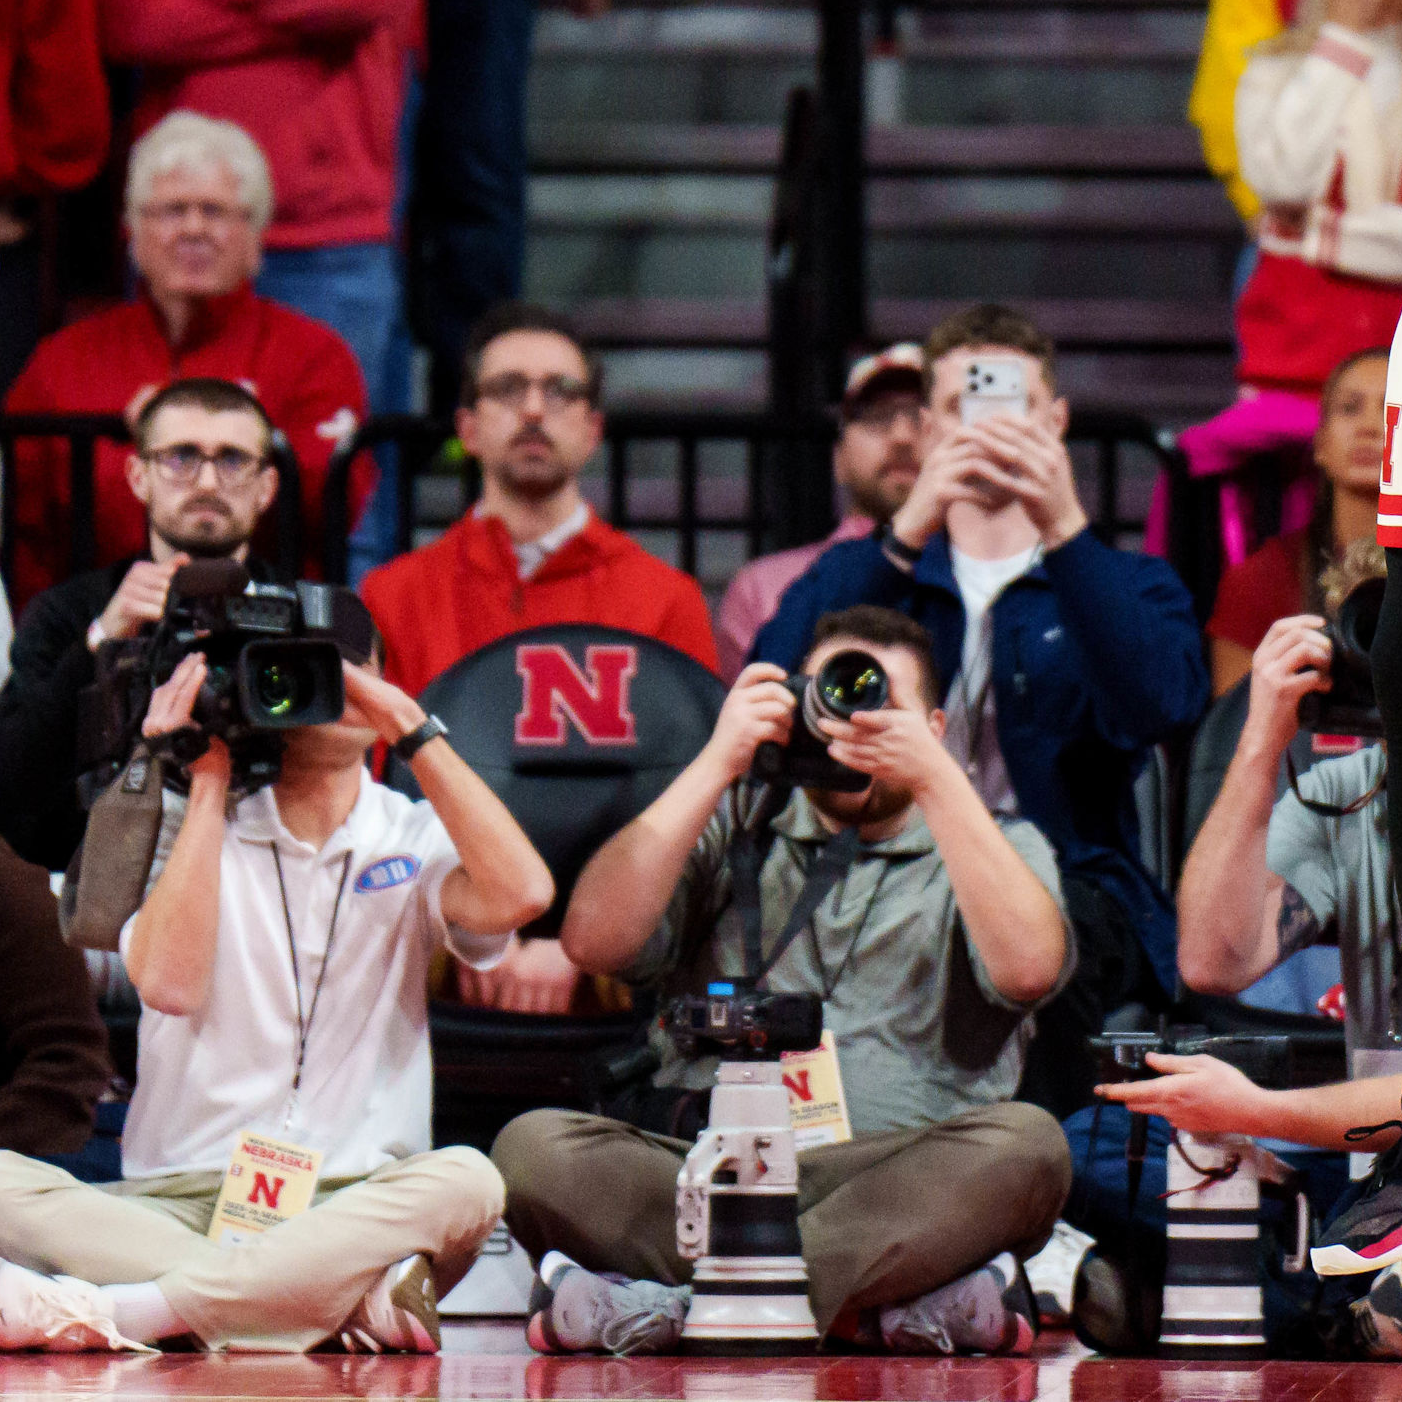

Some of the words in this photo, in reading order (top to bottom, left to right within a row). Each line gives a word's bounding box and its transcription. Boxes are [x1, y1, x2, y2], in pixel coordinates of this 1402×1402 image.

[514, 644, 638, 747] N
[242, 1142, 314, 1172] NEBRASKA
[247, 1171, 285, 1209] N
